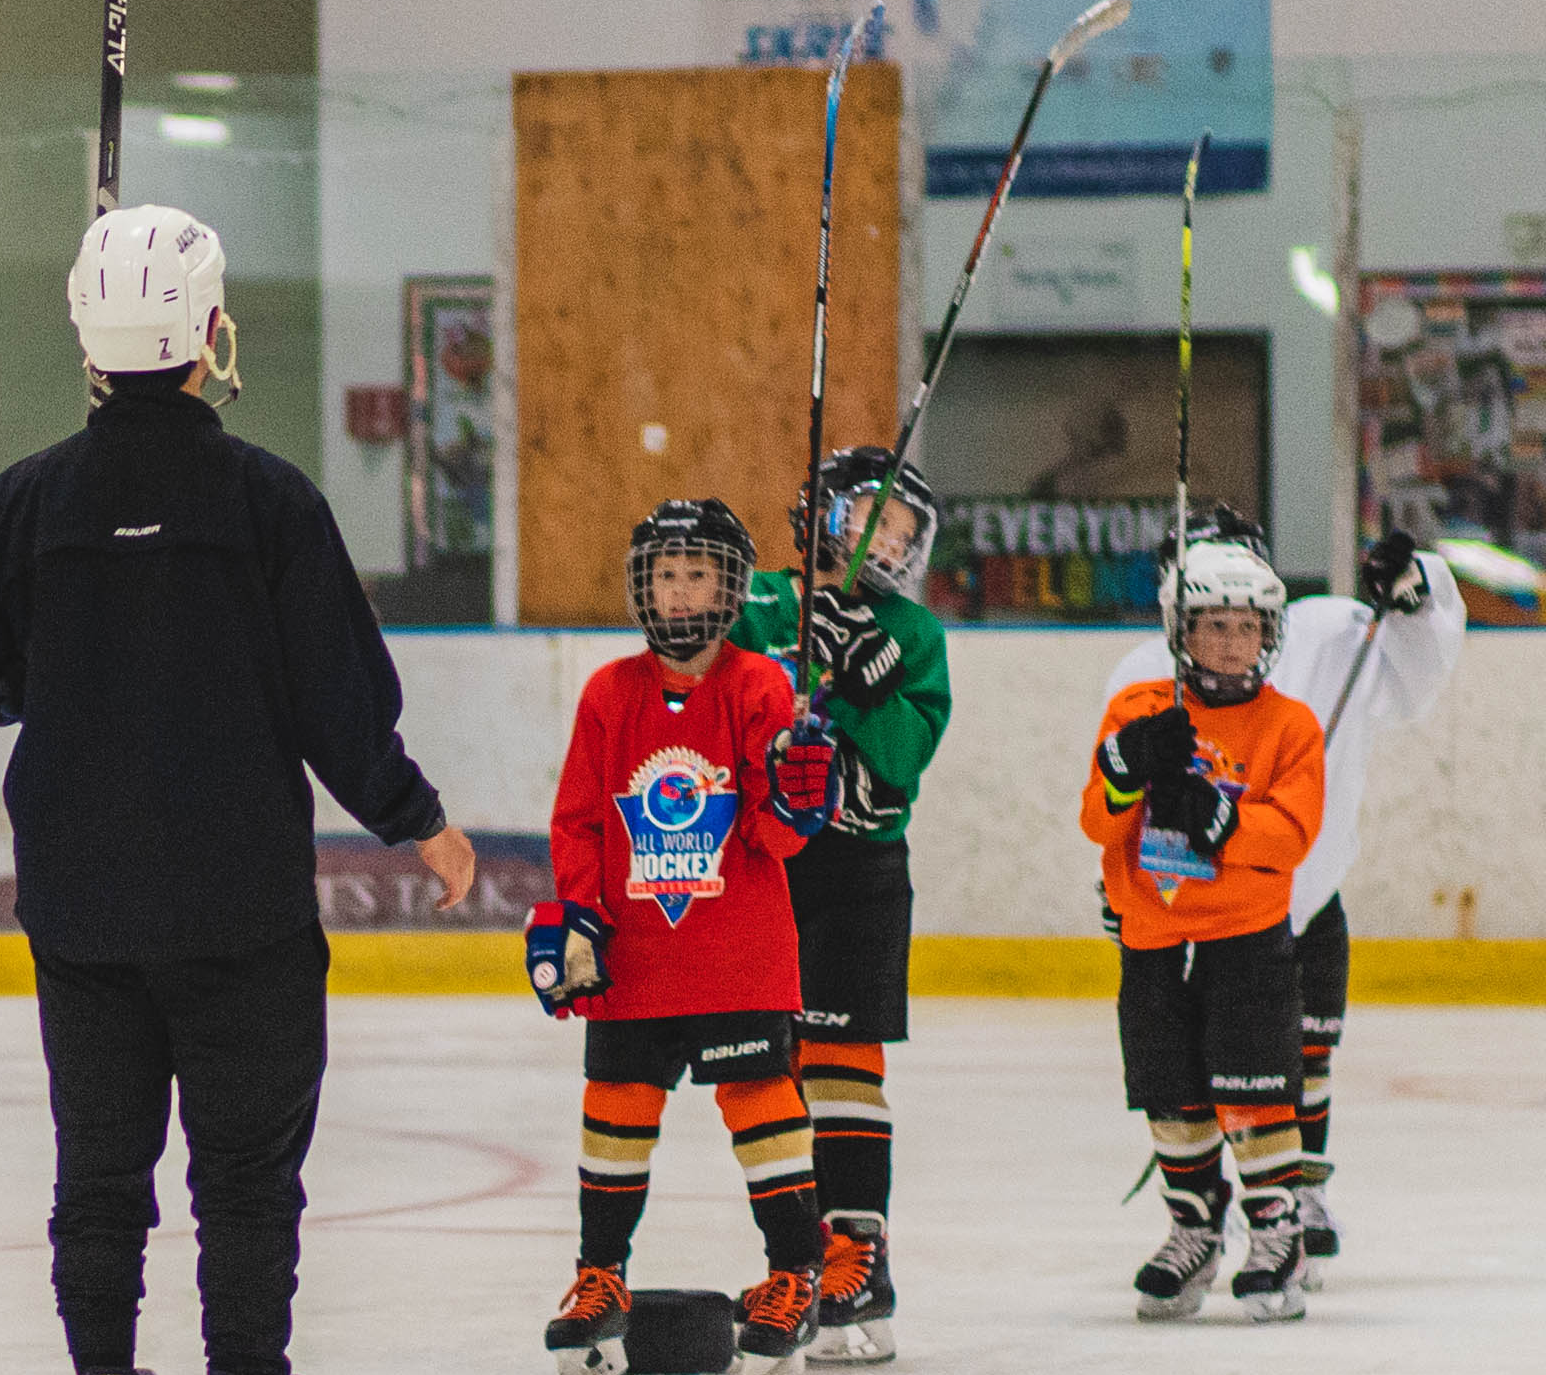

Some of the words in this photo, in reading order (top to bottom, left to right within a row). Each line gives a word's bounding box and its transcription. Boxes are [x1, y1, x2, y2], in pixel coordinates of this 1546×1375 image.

[971, 503, 1168, 557] EVERYON
[661, 832, 714, 852] WORLD
[631, 850, 723, 882] HOCKEY
[701, 1039, 771, 1062] BAUER
